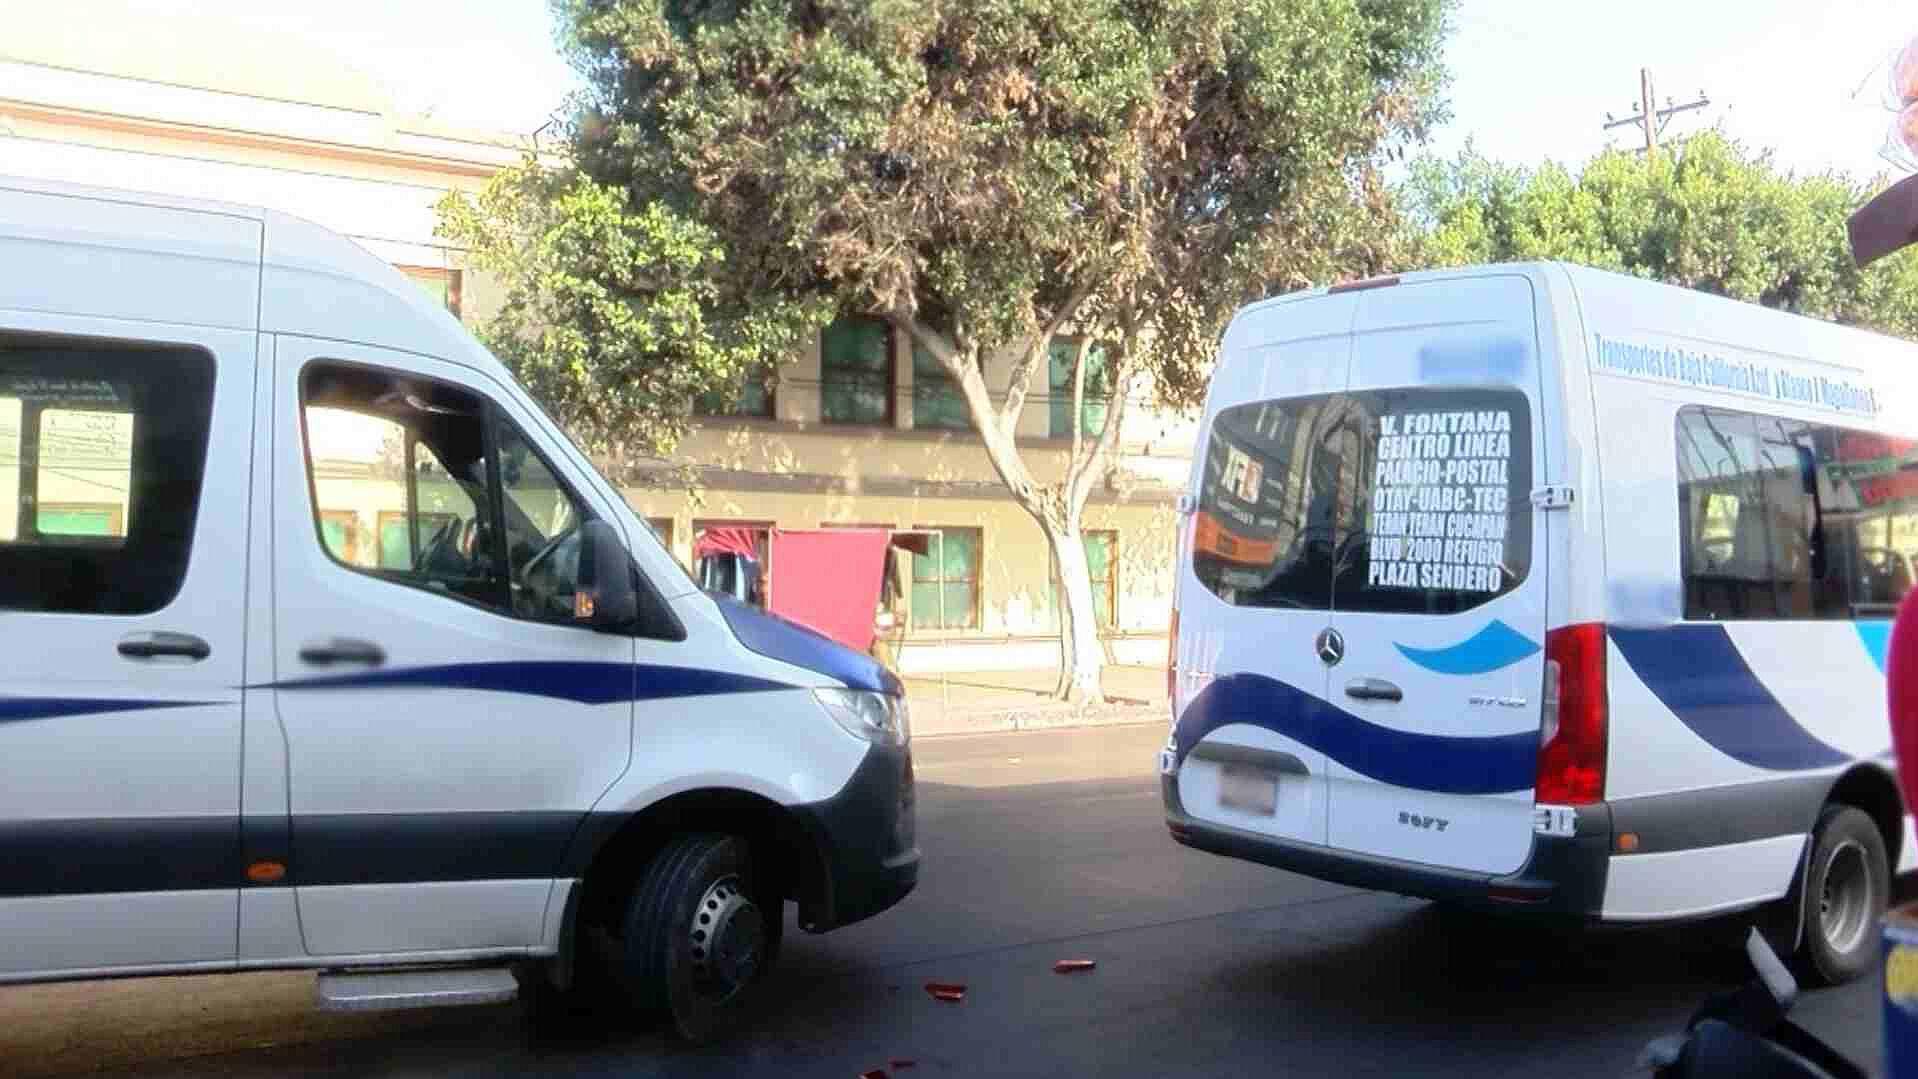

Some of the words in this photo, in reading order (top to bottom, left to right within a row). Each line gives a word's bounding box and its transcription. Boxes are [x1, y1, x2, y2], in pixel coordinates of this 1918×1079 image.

[1379, 414, 1398, 435] V.
[1403, 410, 1512, 434] FONTANA
[1377, 434, 1450, 460] CENTRO
[1454, 432, 1511, 458] LINEA
[1375, 459, 1508, 485] PALACIO-POSTAL
[1374, 487, 1508, 512] OTAY-UABC-TEC
[1407, 538, 1442, 562] 2000
[1444, 540, 1503, 565] REFUGIO
[1368, 560, 1418, 588] PLAZA
[1420, 563, 1502, 592] SENDERO
